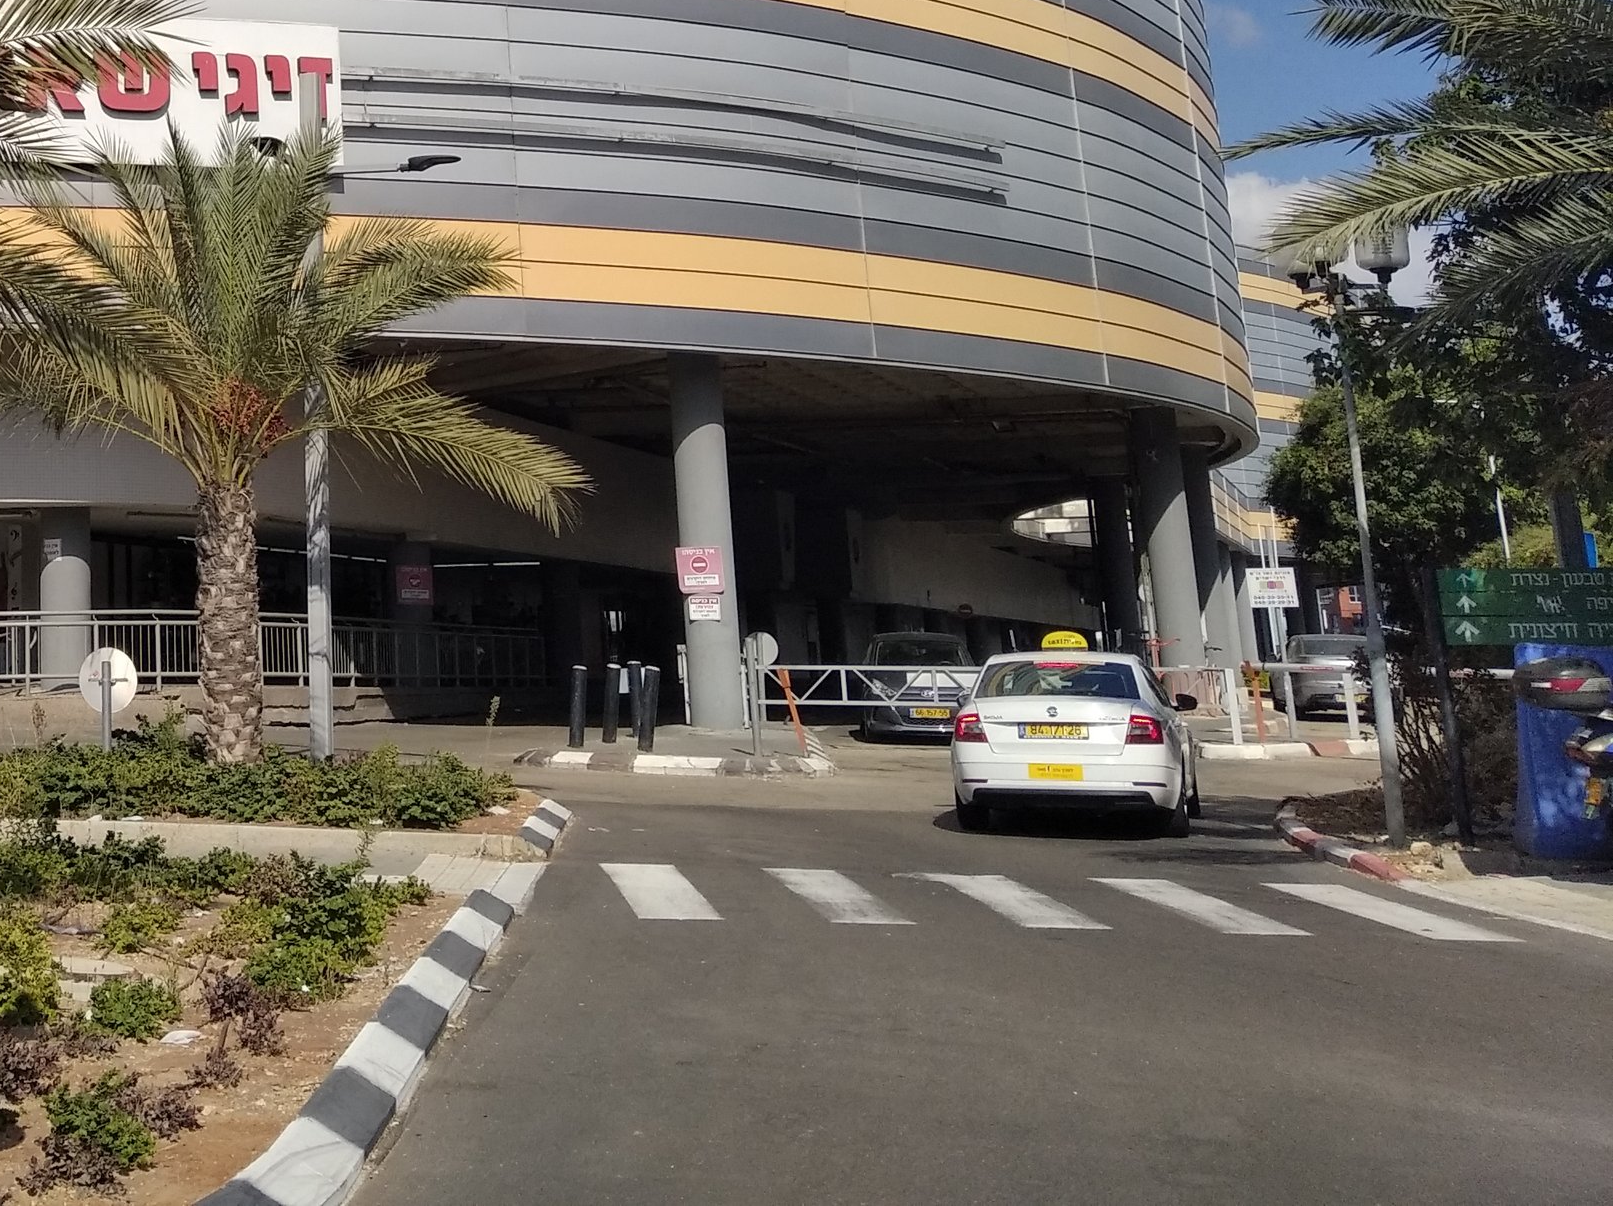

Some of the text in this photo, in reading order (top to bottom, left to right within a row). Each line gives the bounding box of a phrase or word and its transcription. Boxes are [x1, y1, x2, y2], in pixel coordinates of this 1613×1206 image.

[1510, 573, 1550, 586] נצרת
[1560, 572, 1605, 588] טבעון
[1585, 597, 1613, 610] יפה
[1508, 622, 1578, 639] חיצונית
